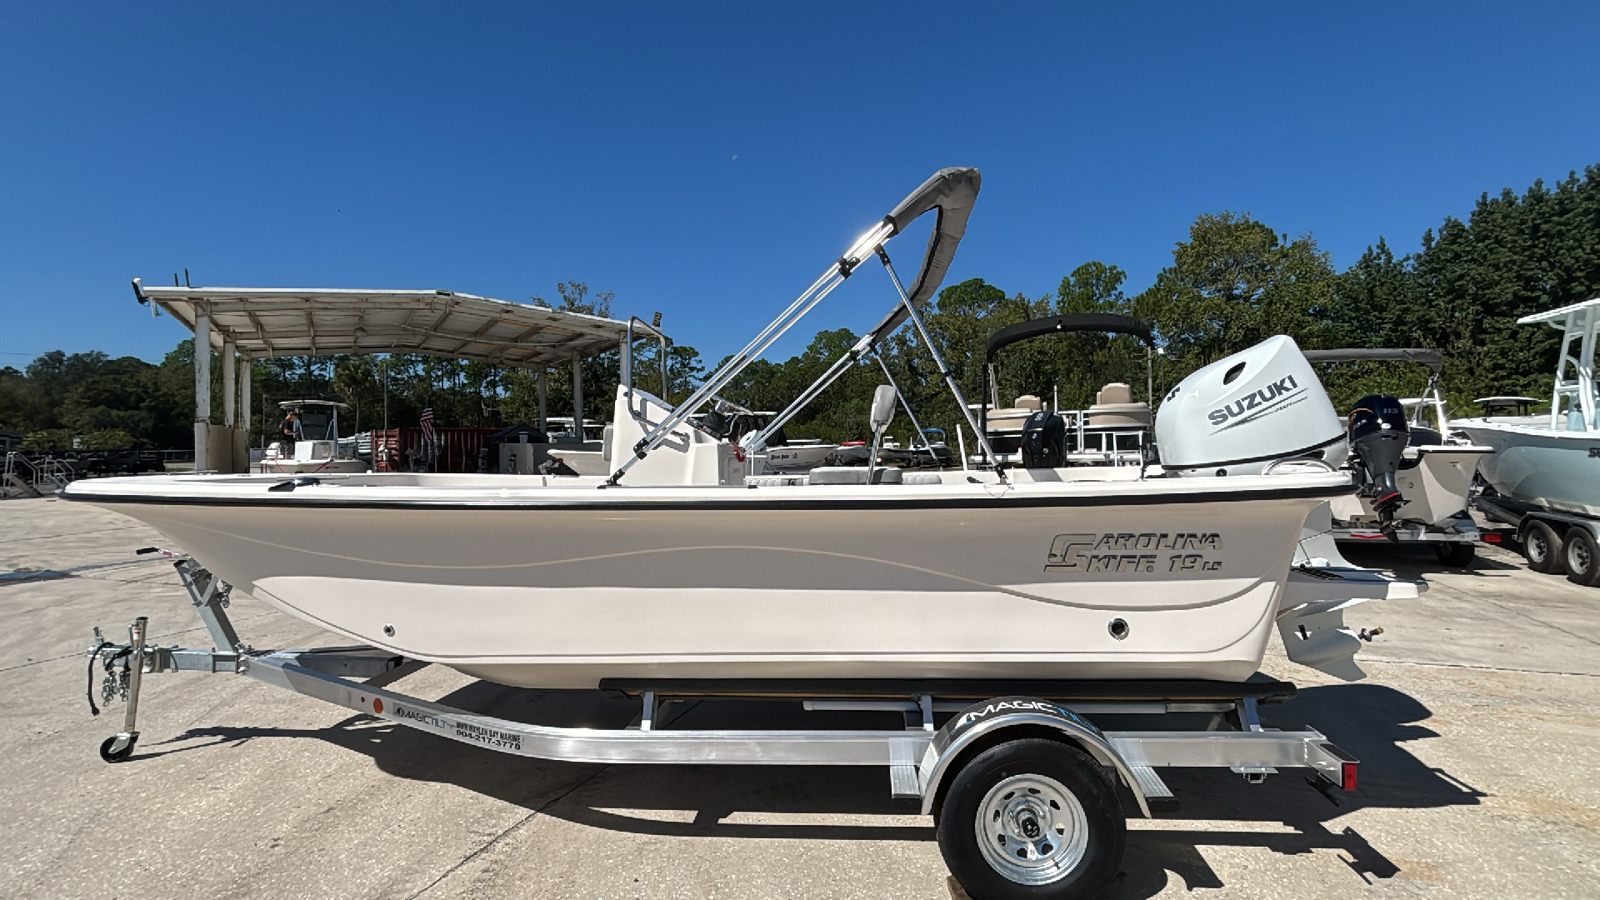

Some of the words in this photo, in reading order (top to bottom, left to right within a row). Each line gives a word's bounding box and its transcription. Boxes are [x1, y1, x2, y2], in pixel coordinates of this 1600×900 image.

[1208, 375, 1298, 425] SUZUKI
[1169, 554, 1203, 572] 19
[456, 730, 521, 750] 904-217-3778
